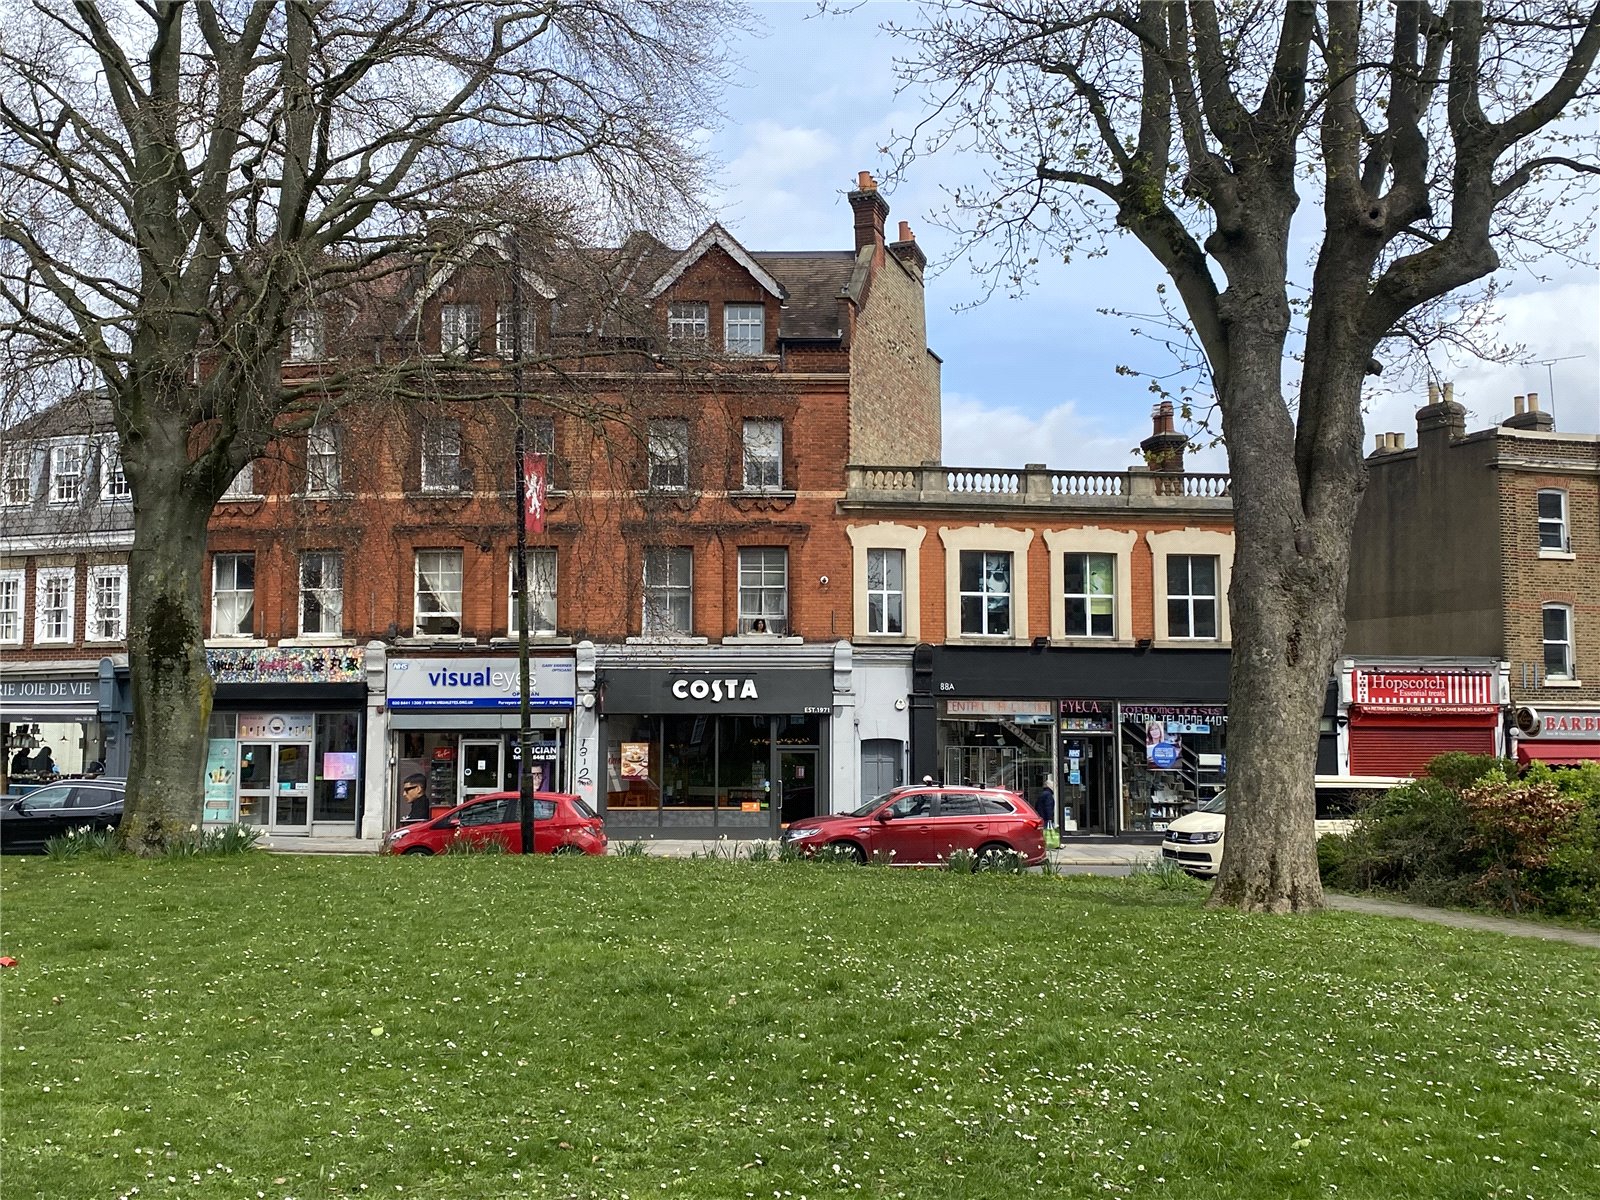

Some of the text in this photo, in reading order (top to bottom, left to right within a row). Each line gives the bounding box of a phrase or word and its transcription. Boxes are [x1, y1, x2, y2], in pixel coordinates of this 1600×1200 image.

[19, 682, 46, 696] JOIE
[49, 682, 67, 696] DE
[70, 682, 92, 695] VIE
[672, 679, 758, 702] COSTA
[940, 682, 955, 691] 88A
[1372, 675, 1446, 693] Hopscotch
